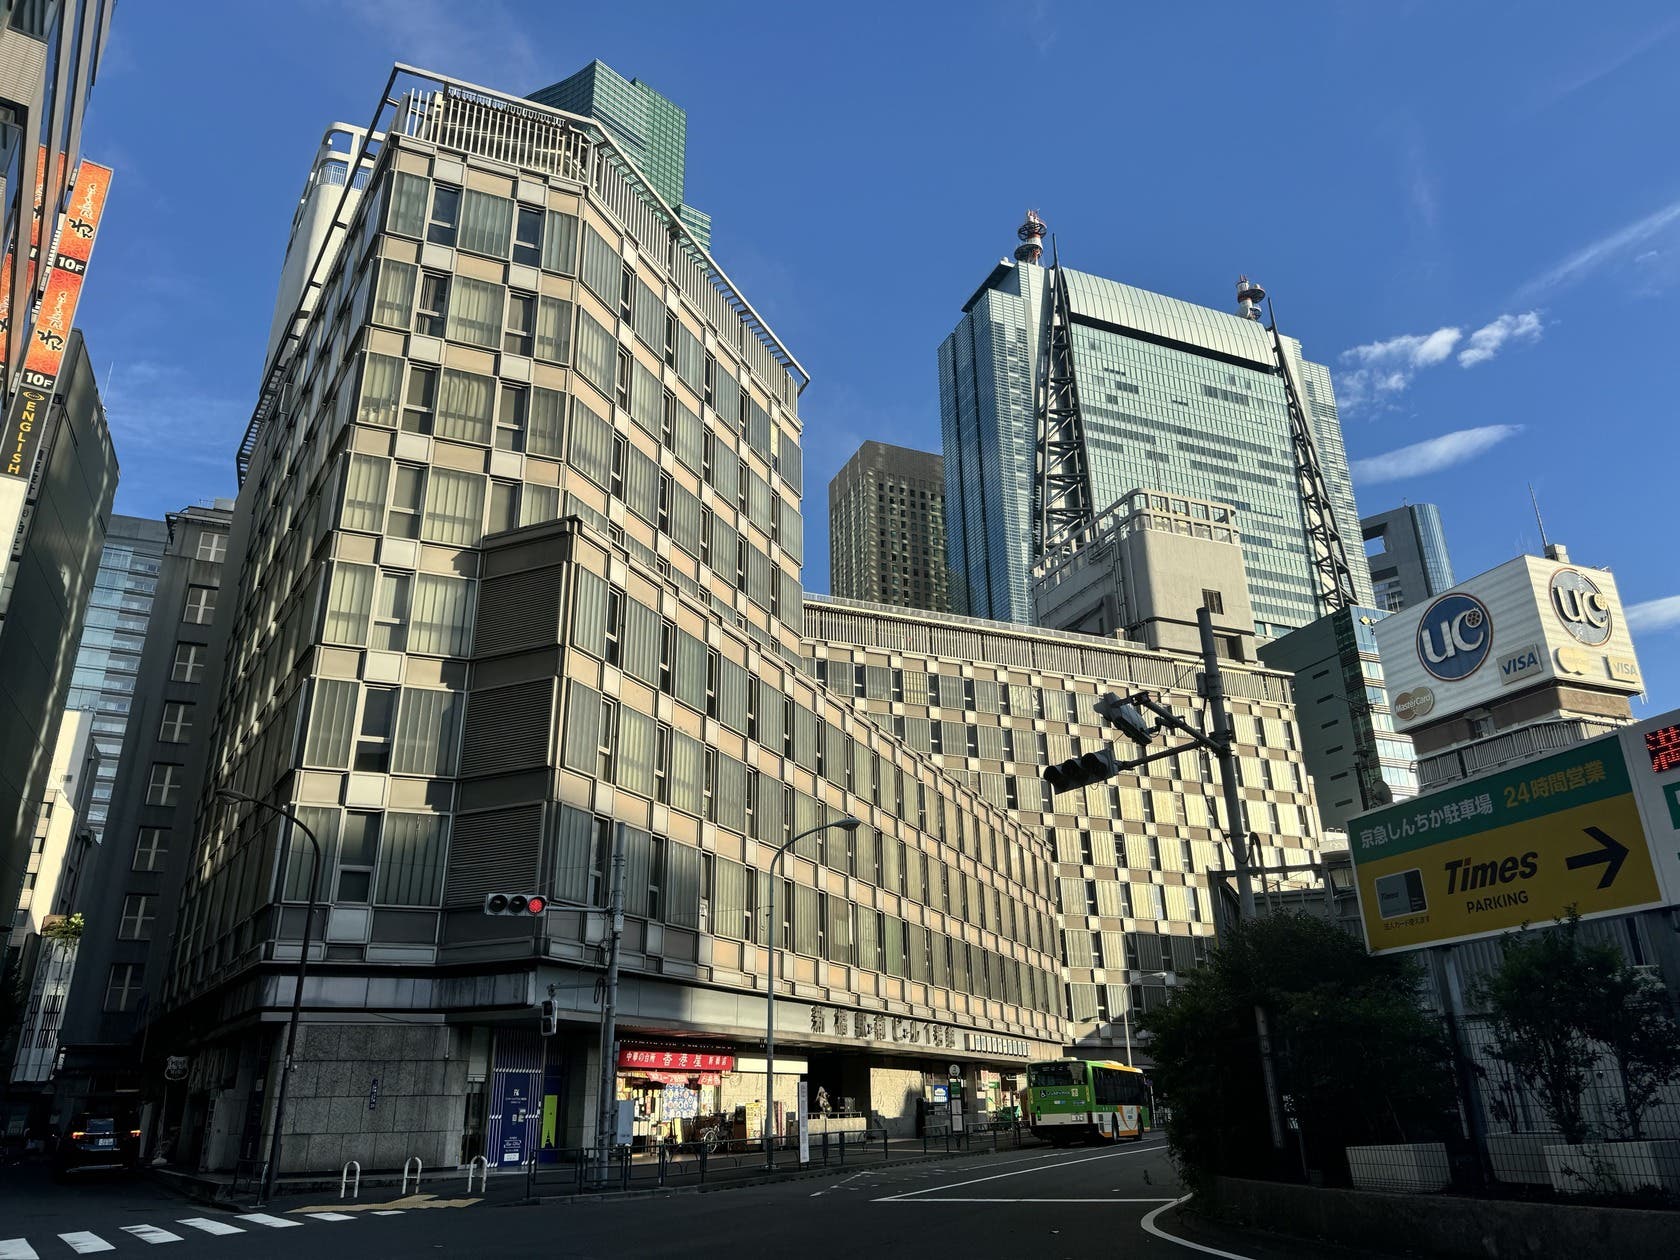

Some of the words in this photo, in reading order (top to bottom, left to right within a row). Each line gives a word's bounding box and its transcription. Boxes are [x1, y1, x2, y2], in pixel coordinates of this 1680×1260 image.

[58, 255, 85, 273] 10F
[25, 371, 53, 389] 10F
[6, 399, 37, 475] ENGLISH
[1554, 586, 1608, 628] UC
[1421, 609, 1484, 664] UC
[1502, 651, 1540, 676] VISA
[1612, 662, 1638, 677] VISA
[1394, 693, 1432, 714] MasterCard
[1360, 793, 1494, 849] 京急しんちか駐車場
[1503, 759, 1607, 808] 24時間営業
[1444, 851, 1539, 895] Times
[1466, 890, 1529, 914] PARKING
